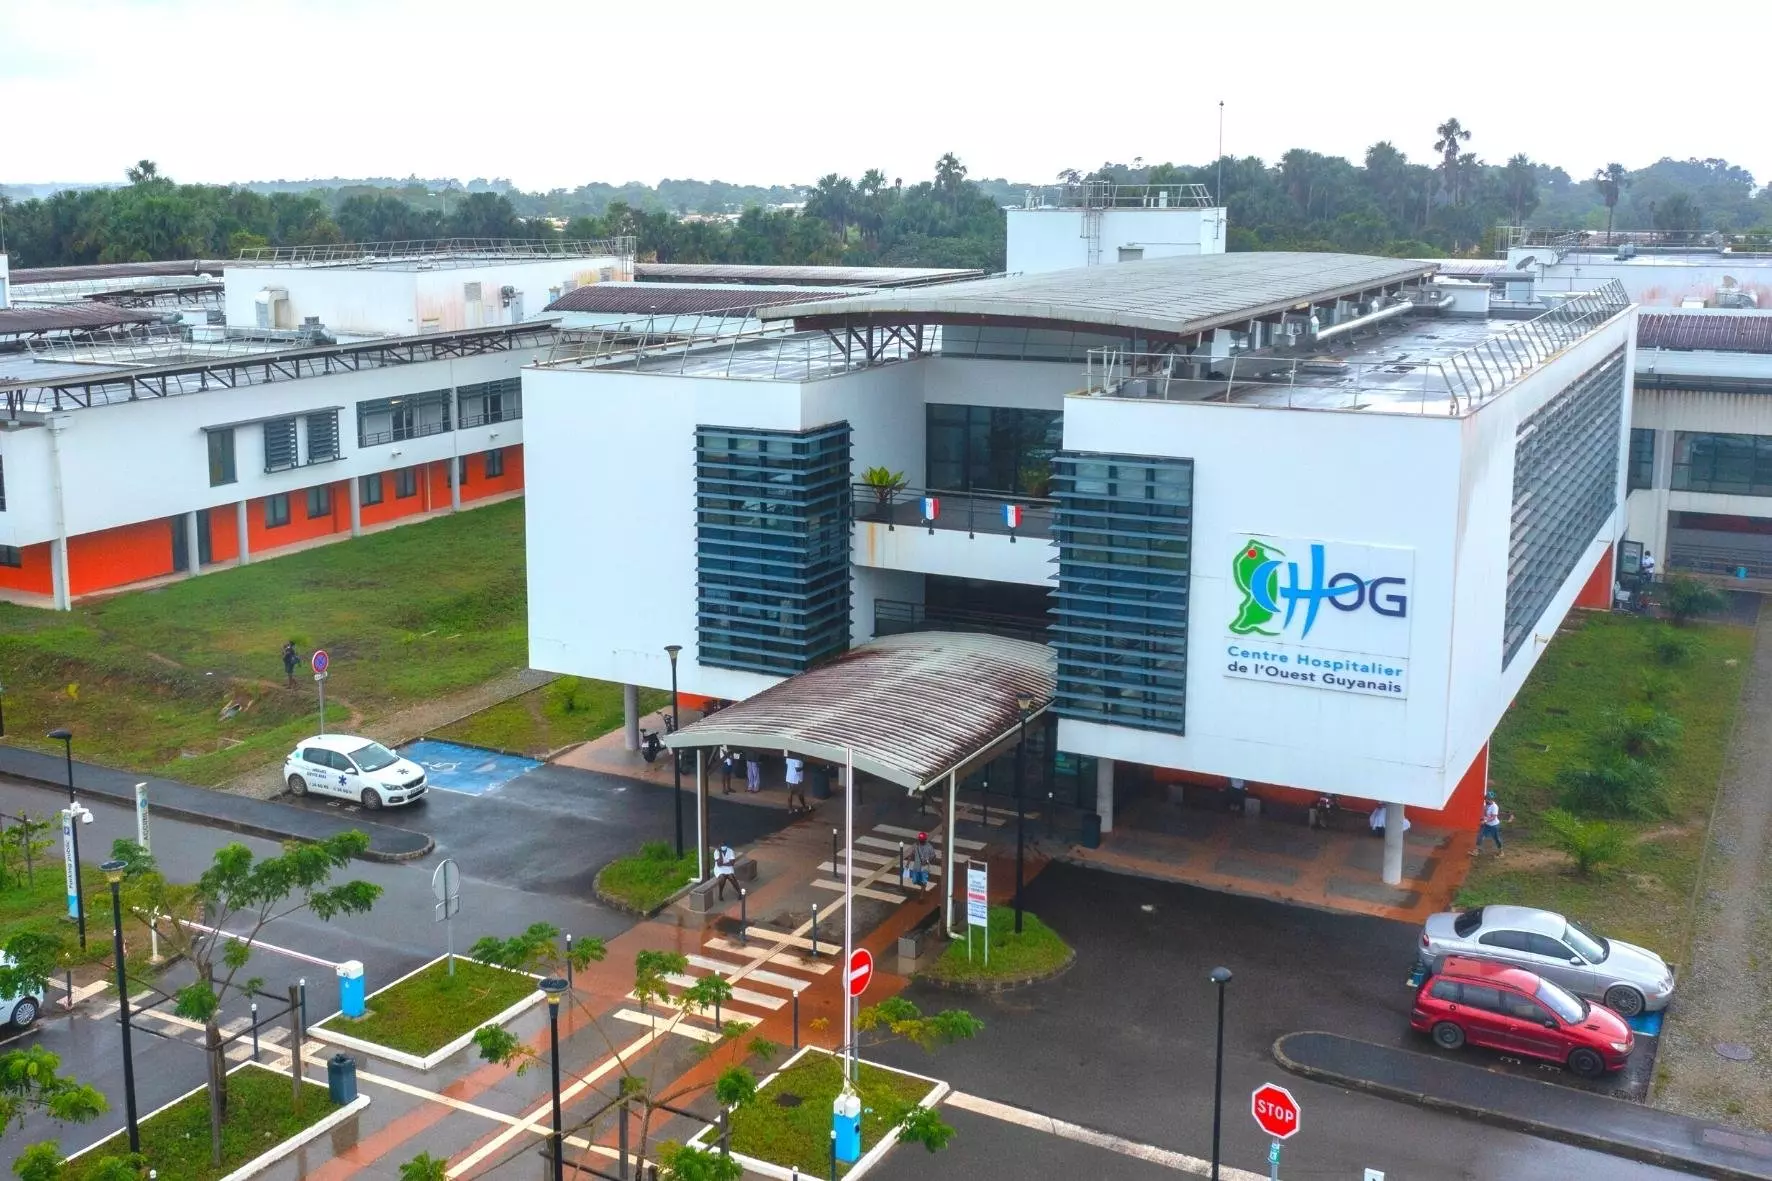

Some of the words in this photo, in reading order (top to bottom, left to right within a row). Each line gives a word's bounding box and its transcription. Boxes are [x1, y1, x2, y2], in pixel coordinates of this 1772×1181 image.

[1227, 645, 1289, 663] Centre
[1297, 654, 1404, 677] Hospitalier
[1227, 661, 1248, 674] de
[1254, 662, 1316, 682] l'Ouest
[1322, 673, 1402, 693] Guyanais
[1257, 1099, 1294, 1123] STOP
